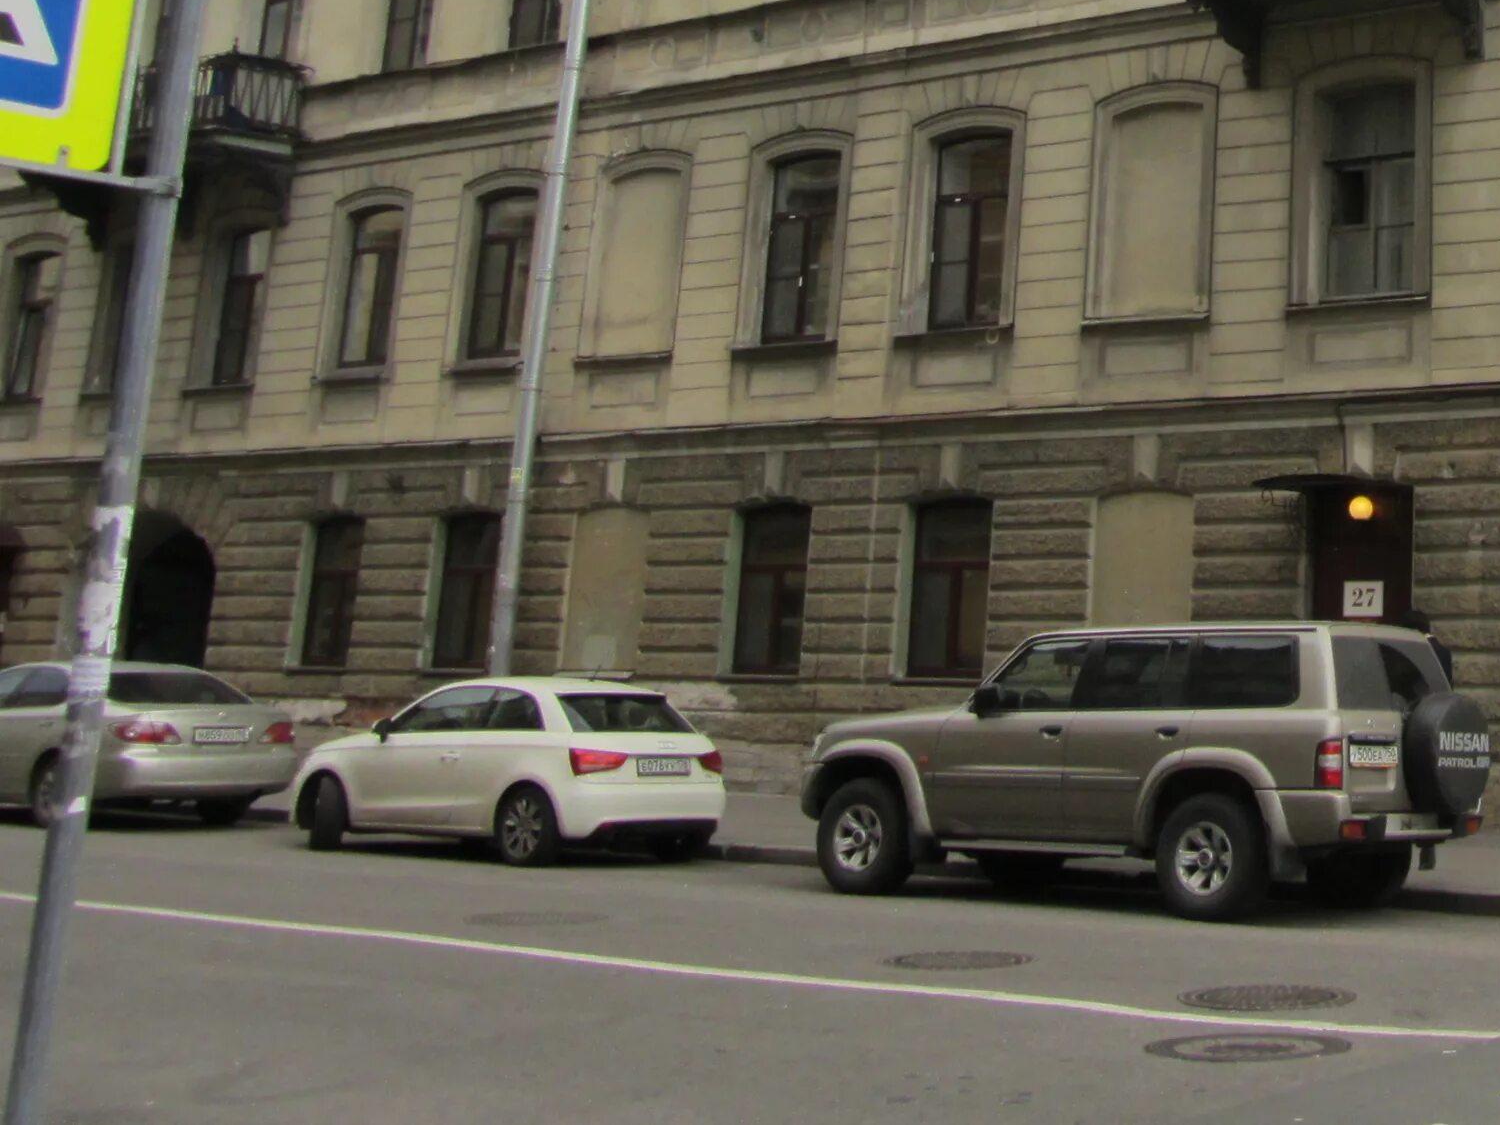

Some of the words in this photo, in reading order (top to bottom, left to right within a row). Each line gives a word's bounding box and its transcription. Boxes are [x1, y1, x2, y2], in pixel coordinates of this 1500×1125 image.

[1352, 587, 1376, 607] 27
[1440, 731, 1489, 752] NISSAN
[1438, 757, 1476, 768] PATROL
